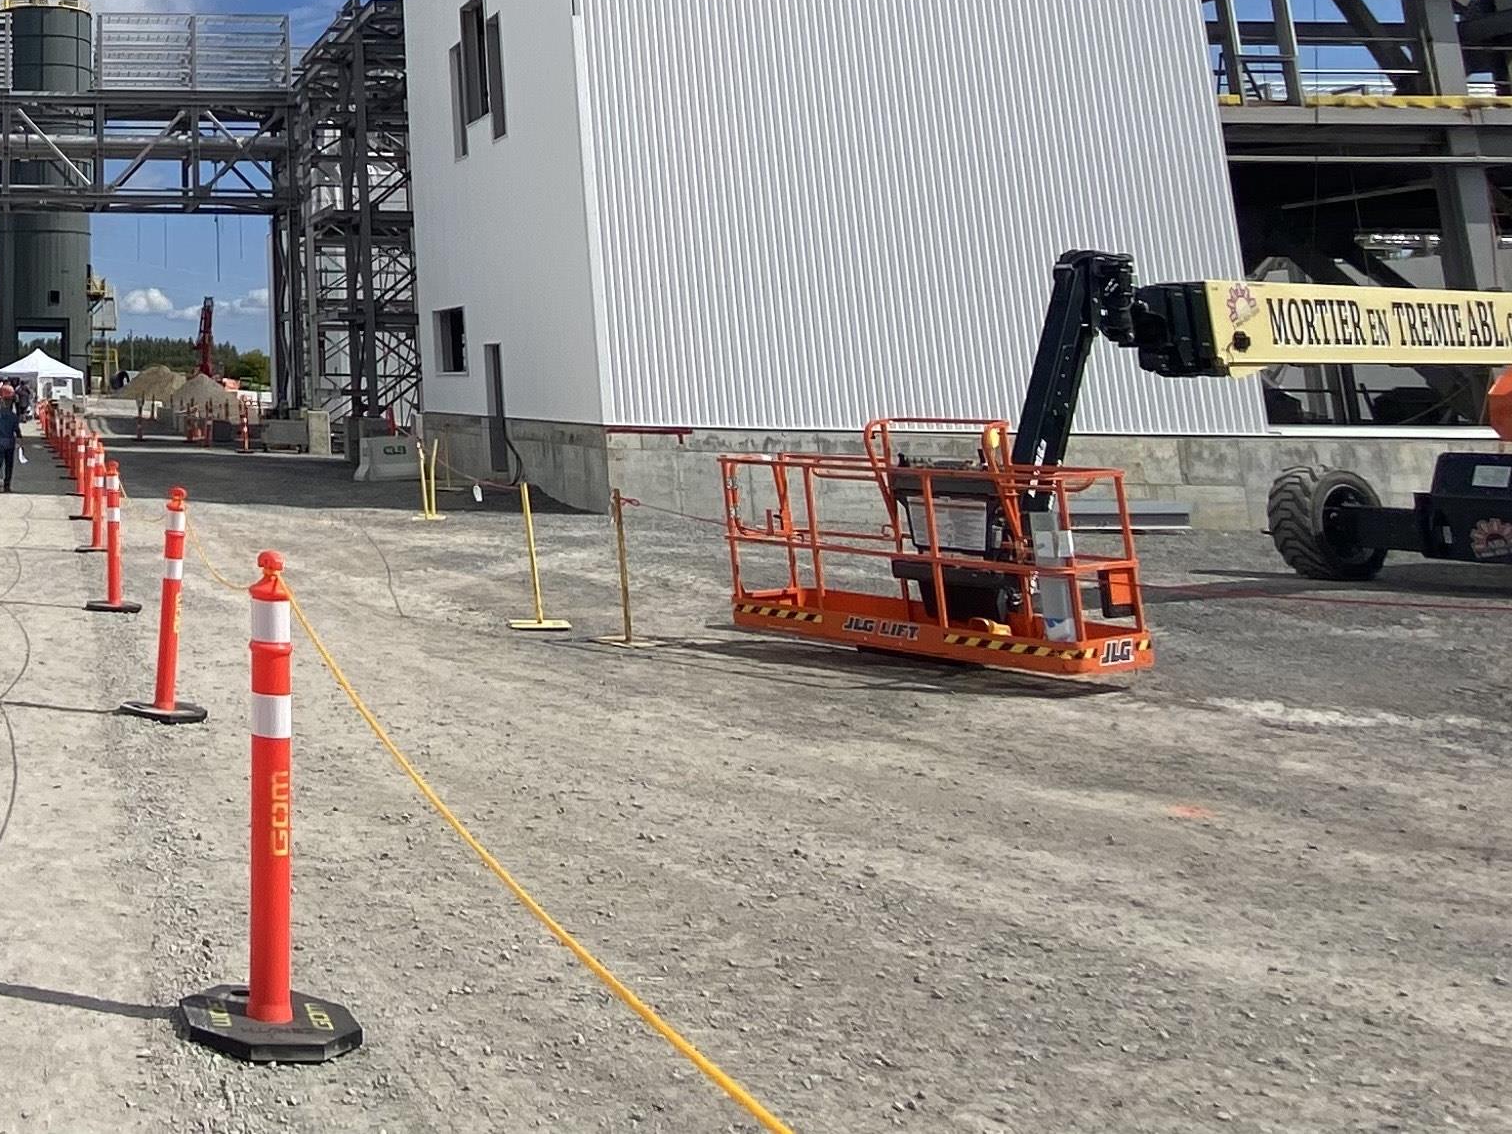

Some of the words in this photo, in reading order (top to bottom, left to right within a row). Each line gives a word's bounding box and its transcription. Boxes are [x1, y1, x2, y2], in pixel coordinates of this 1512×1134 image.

[1266, 297, 1367, 346] MORTIER
[1366, 308, 1391, 346] EN
[1392, 301, 1466, 347] TREMIE
[844, 617, 875, 632] JLG
[879, 622, 919, 640] LIFT
[1101, 640, 1133, 665] JLG
